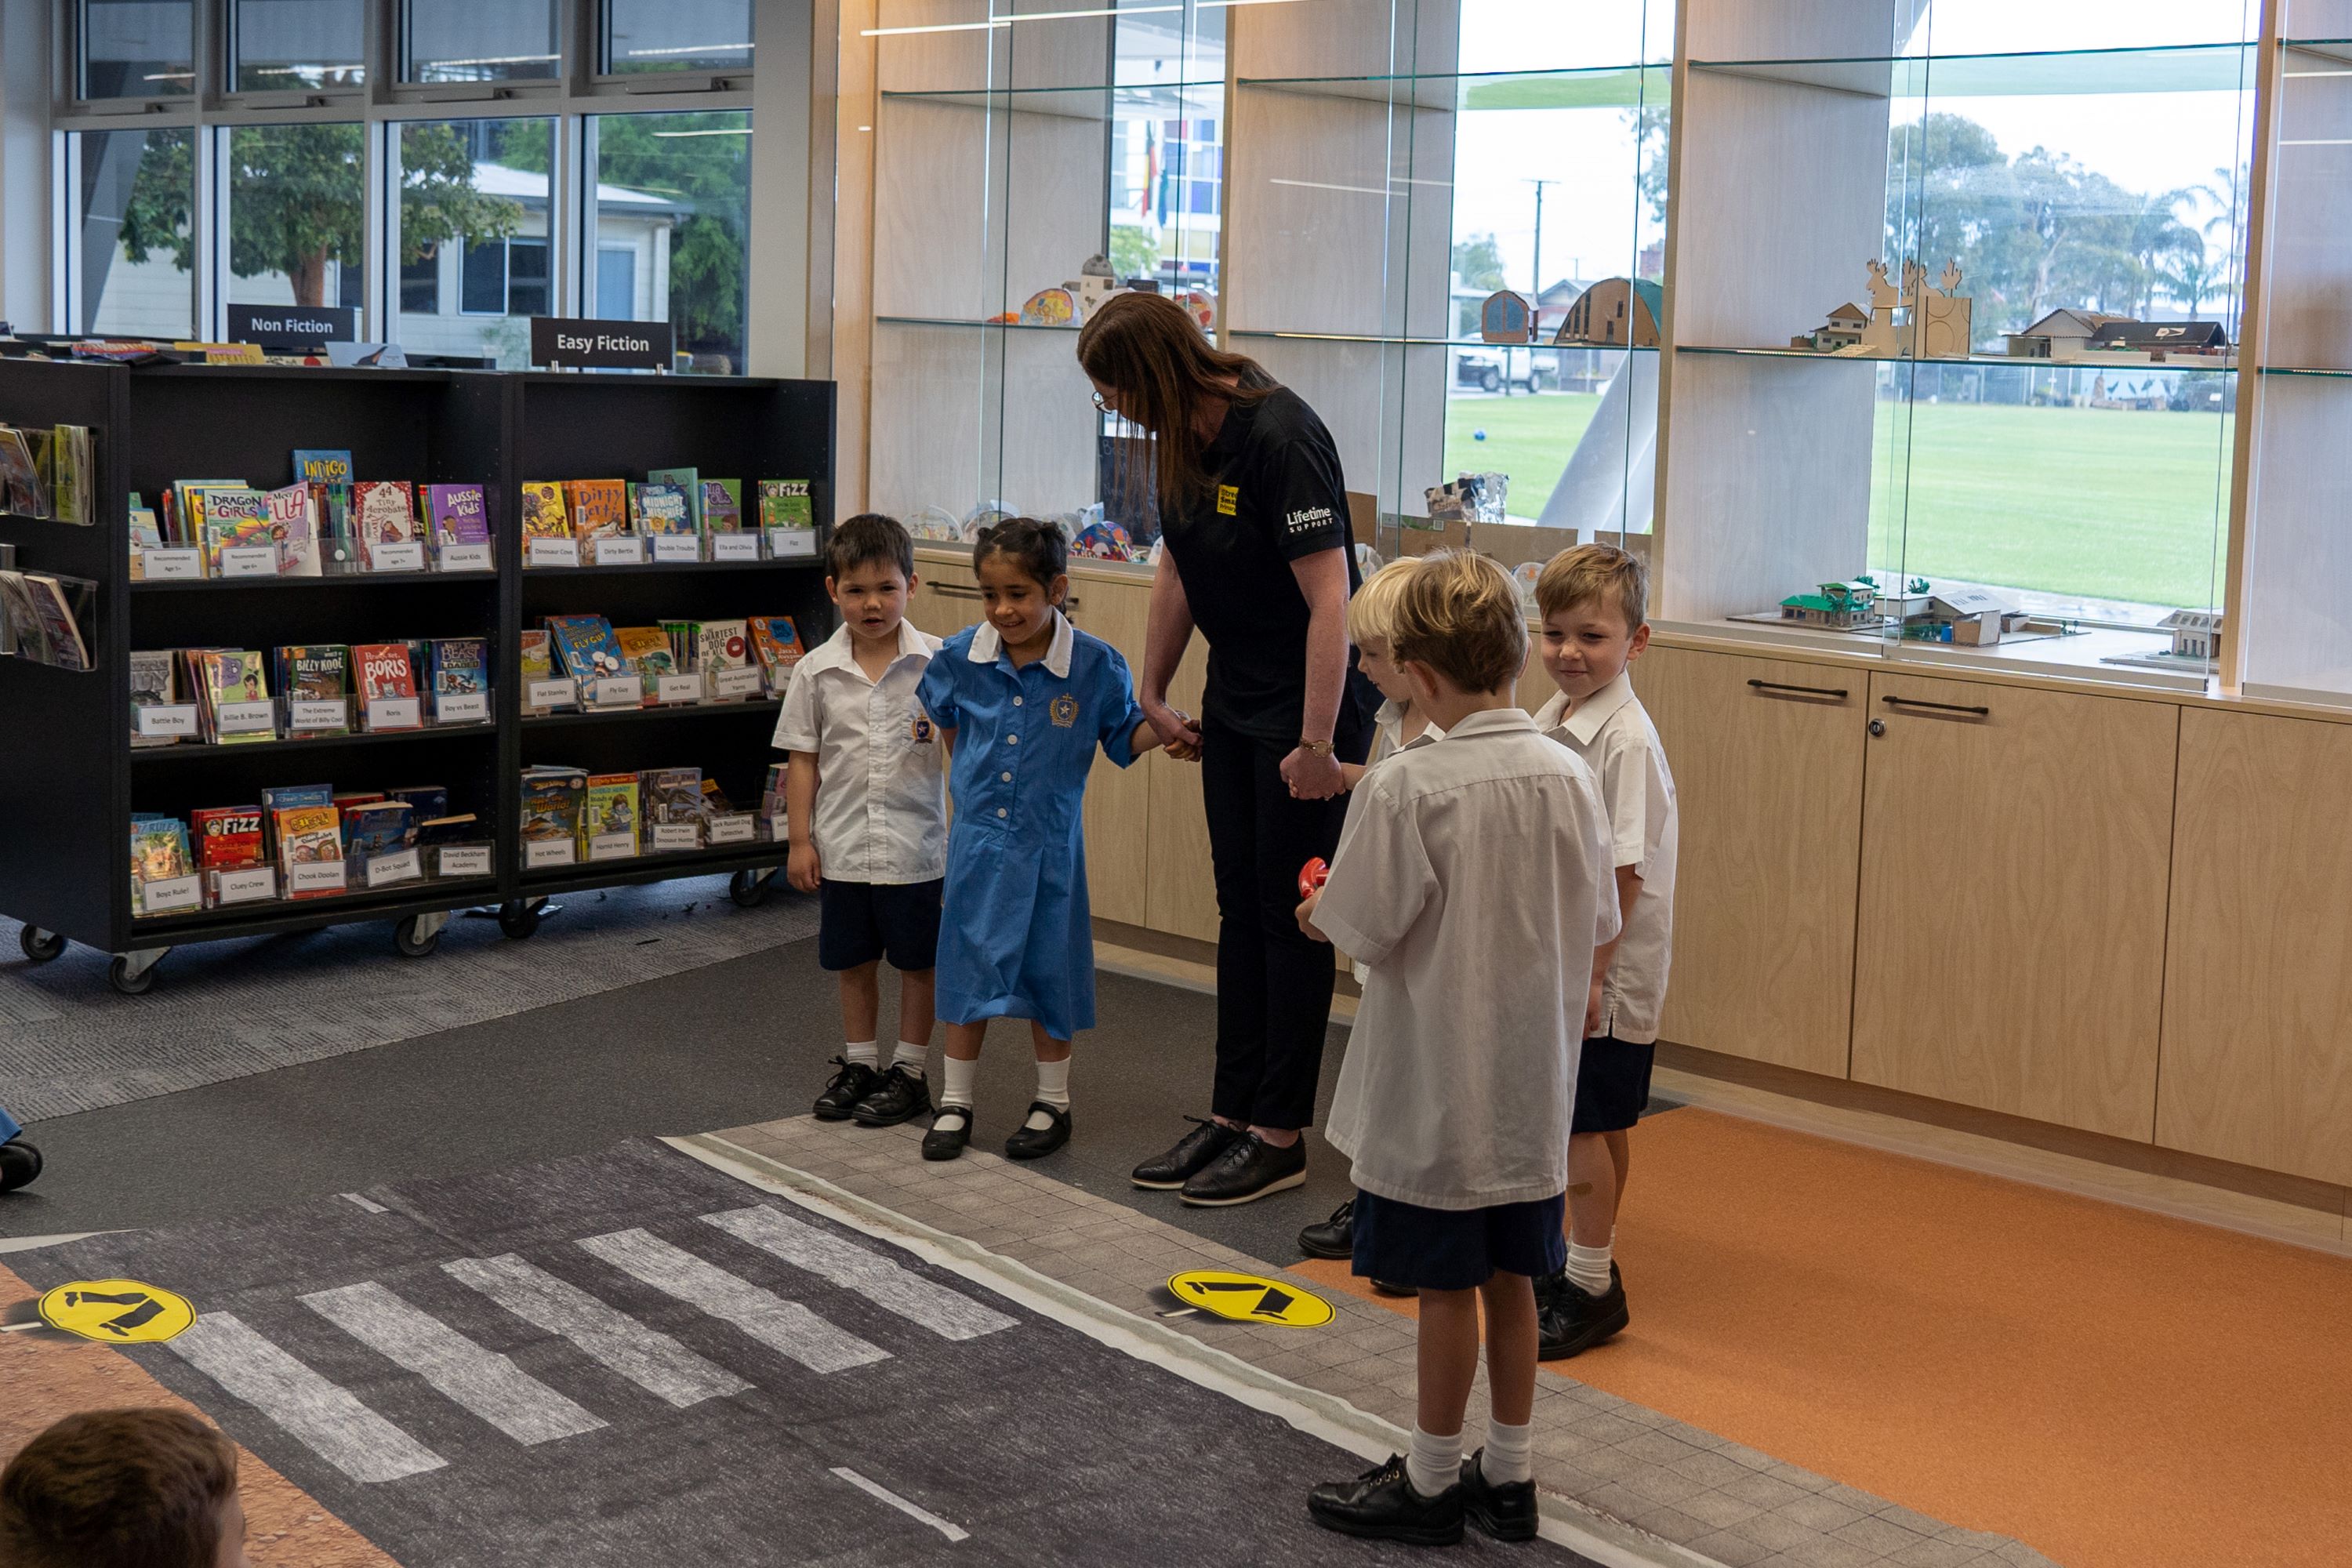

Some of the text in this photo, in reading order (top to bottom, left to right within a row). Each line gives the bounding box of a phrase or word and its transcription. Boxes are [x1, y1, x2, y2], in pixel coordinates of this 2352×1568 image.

[252, 318, 333, 334] Non Fiction
[557, 334, 649, 354] Easy Fiction
[379, 486, 393, 499] 44
[579, 488, 622, 506] Dirty
[209, 494, 263, 508] DRAGON
[376, 499, 396, 508] Tiny
[456, 501, 480, 517] Kids
[217, 506, 258, 519] GIRLS
[585, 504, 622, 522] ertie
[1286, 506, 1331, 526] Lifetime
[1289, 517, 1334, 534] SUPPORT
[699, 627, 739, 643] SMARTEST
[708, 639, 726, 650] DOG
[296, 656, 344, 672] BILLY KOOL
[364, 659, 408, 681] BORIS
[733, 673, 758, 681] Australian
[375, 861, 411, 874] D-Bot Squad
[172, 888, 189, 897] Rule!
[230, 883, 248, 891] Cluey
